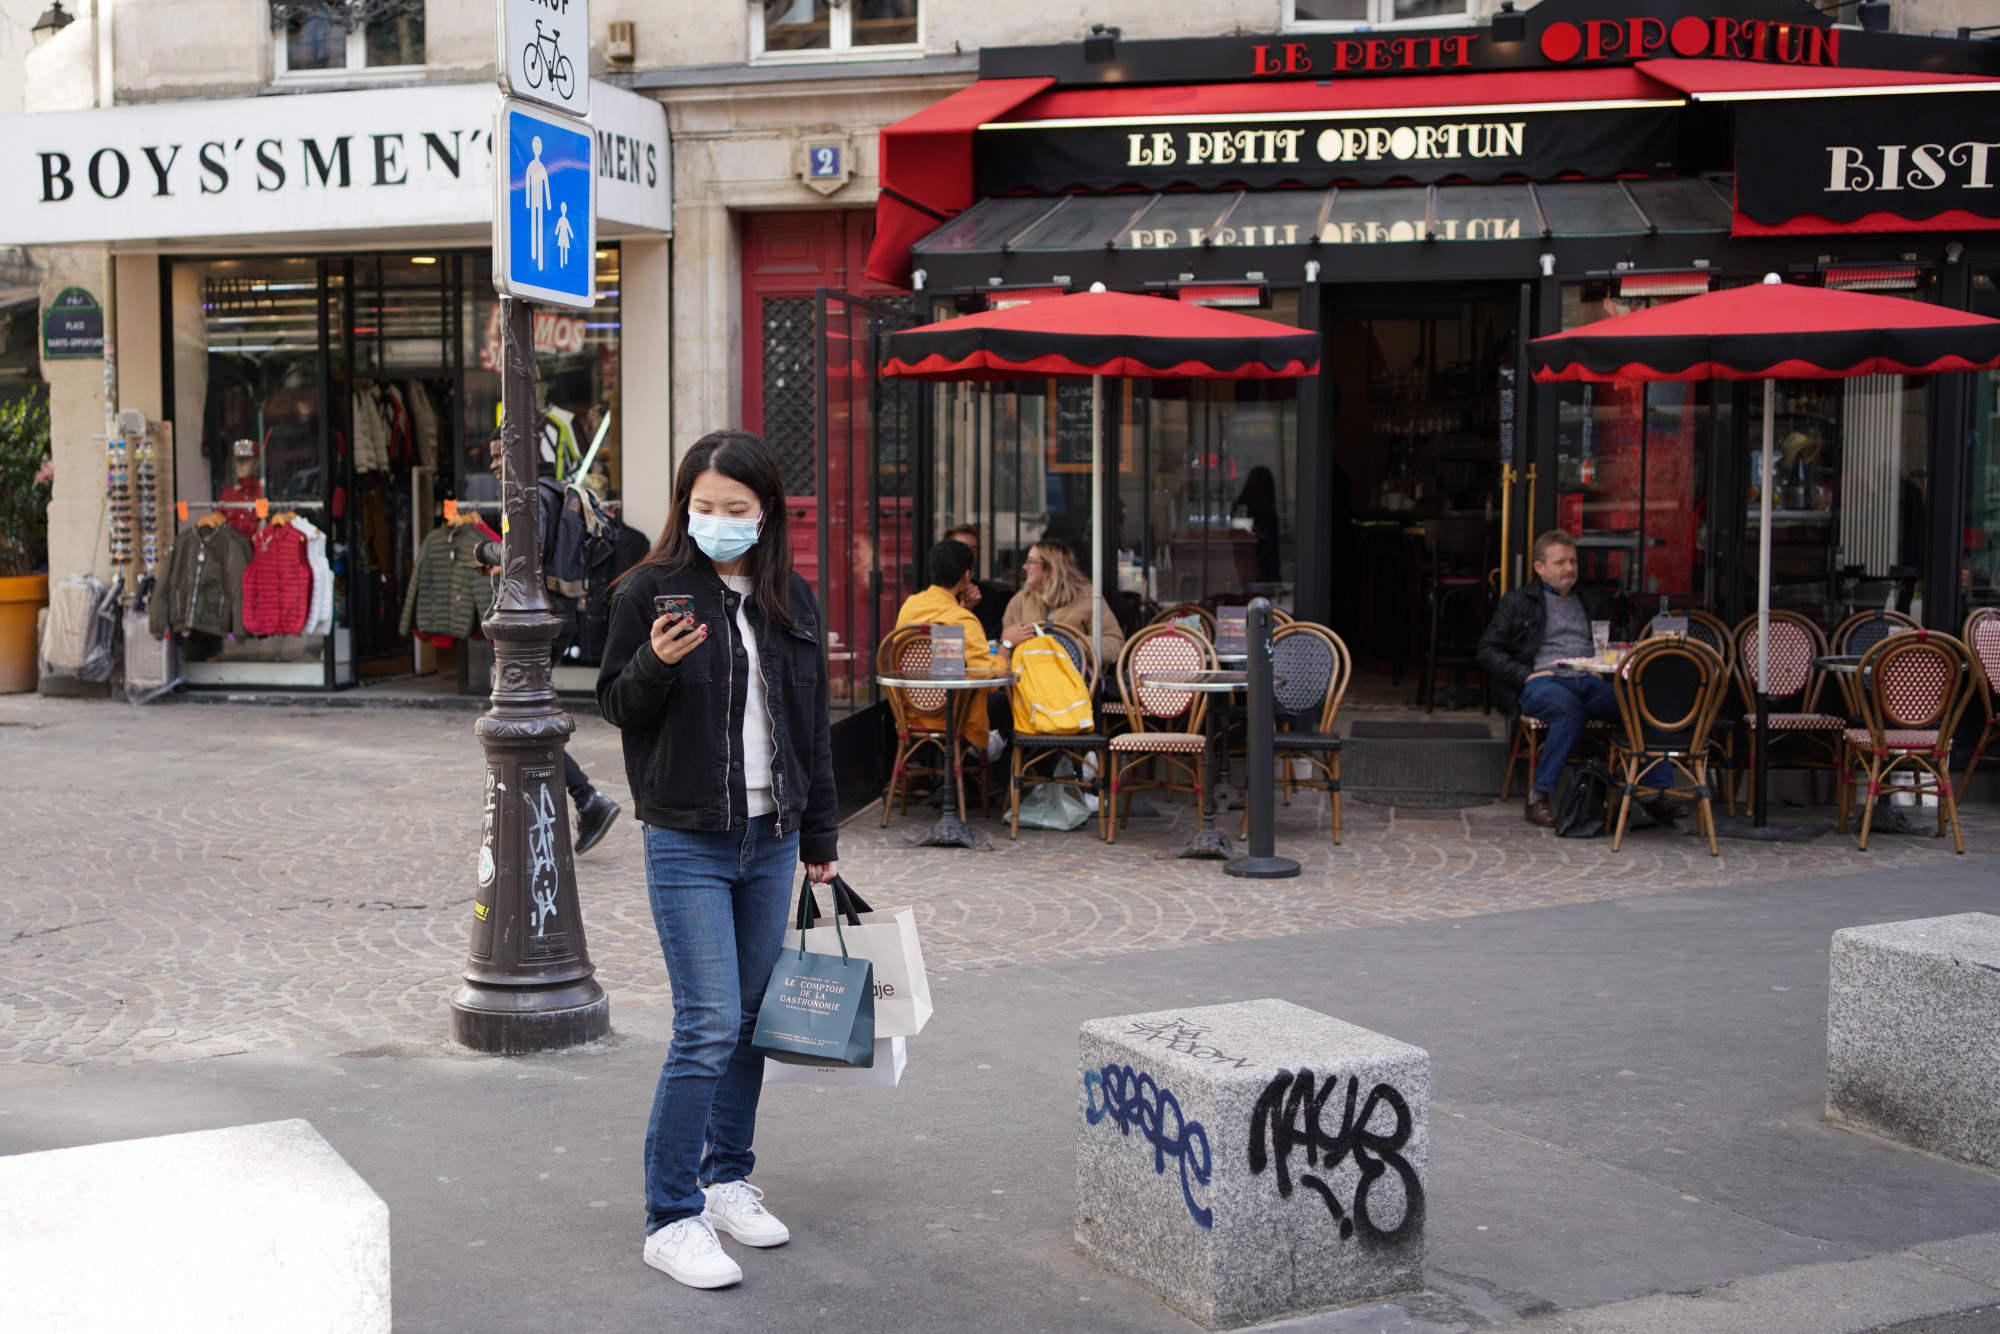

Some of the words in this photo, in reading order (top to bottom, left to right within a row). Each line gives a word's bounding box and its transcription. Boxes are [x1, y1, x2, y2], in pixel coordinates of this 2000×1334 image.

[1252, 43, 1312, 75] LE
[1333, 34, 1478, 71] PETIT
[1541, 16, 1840, 66] OPPORTUN
[1127, 133, 1176, 166] LE
[1187, 128, 1305, 165] PETIT
[1317, 122, 1526, 162] OPPORTUN
[817, 148, 834, 175] 2
[784, 978, 796, 987] LE
[800, 980, 845, 995] COMPTOIR
[800, 989, 811, 997] DE
[815, 992, 825, 1000] LA
[779, 994, 841, 1012] GASTRONOMIE
